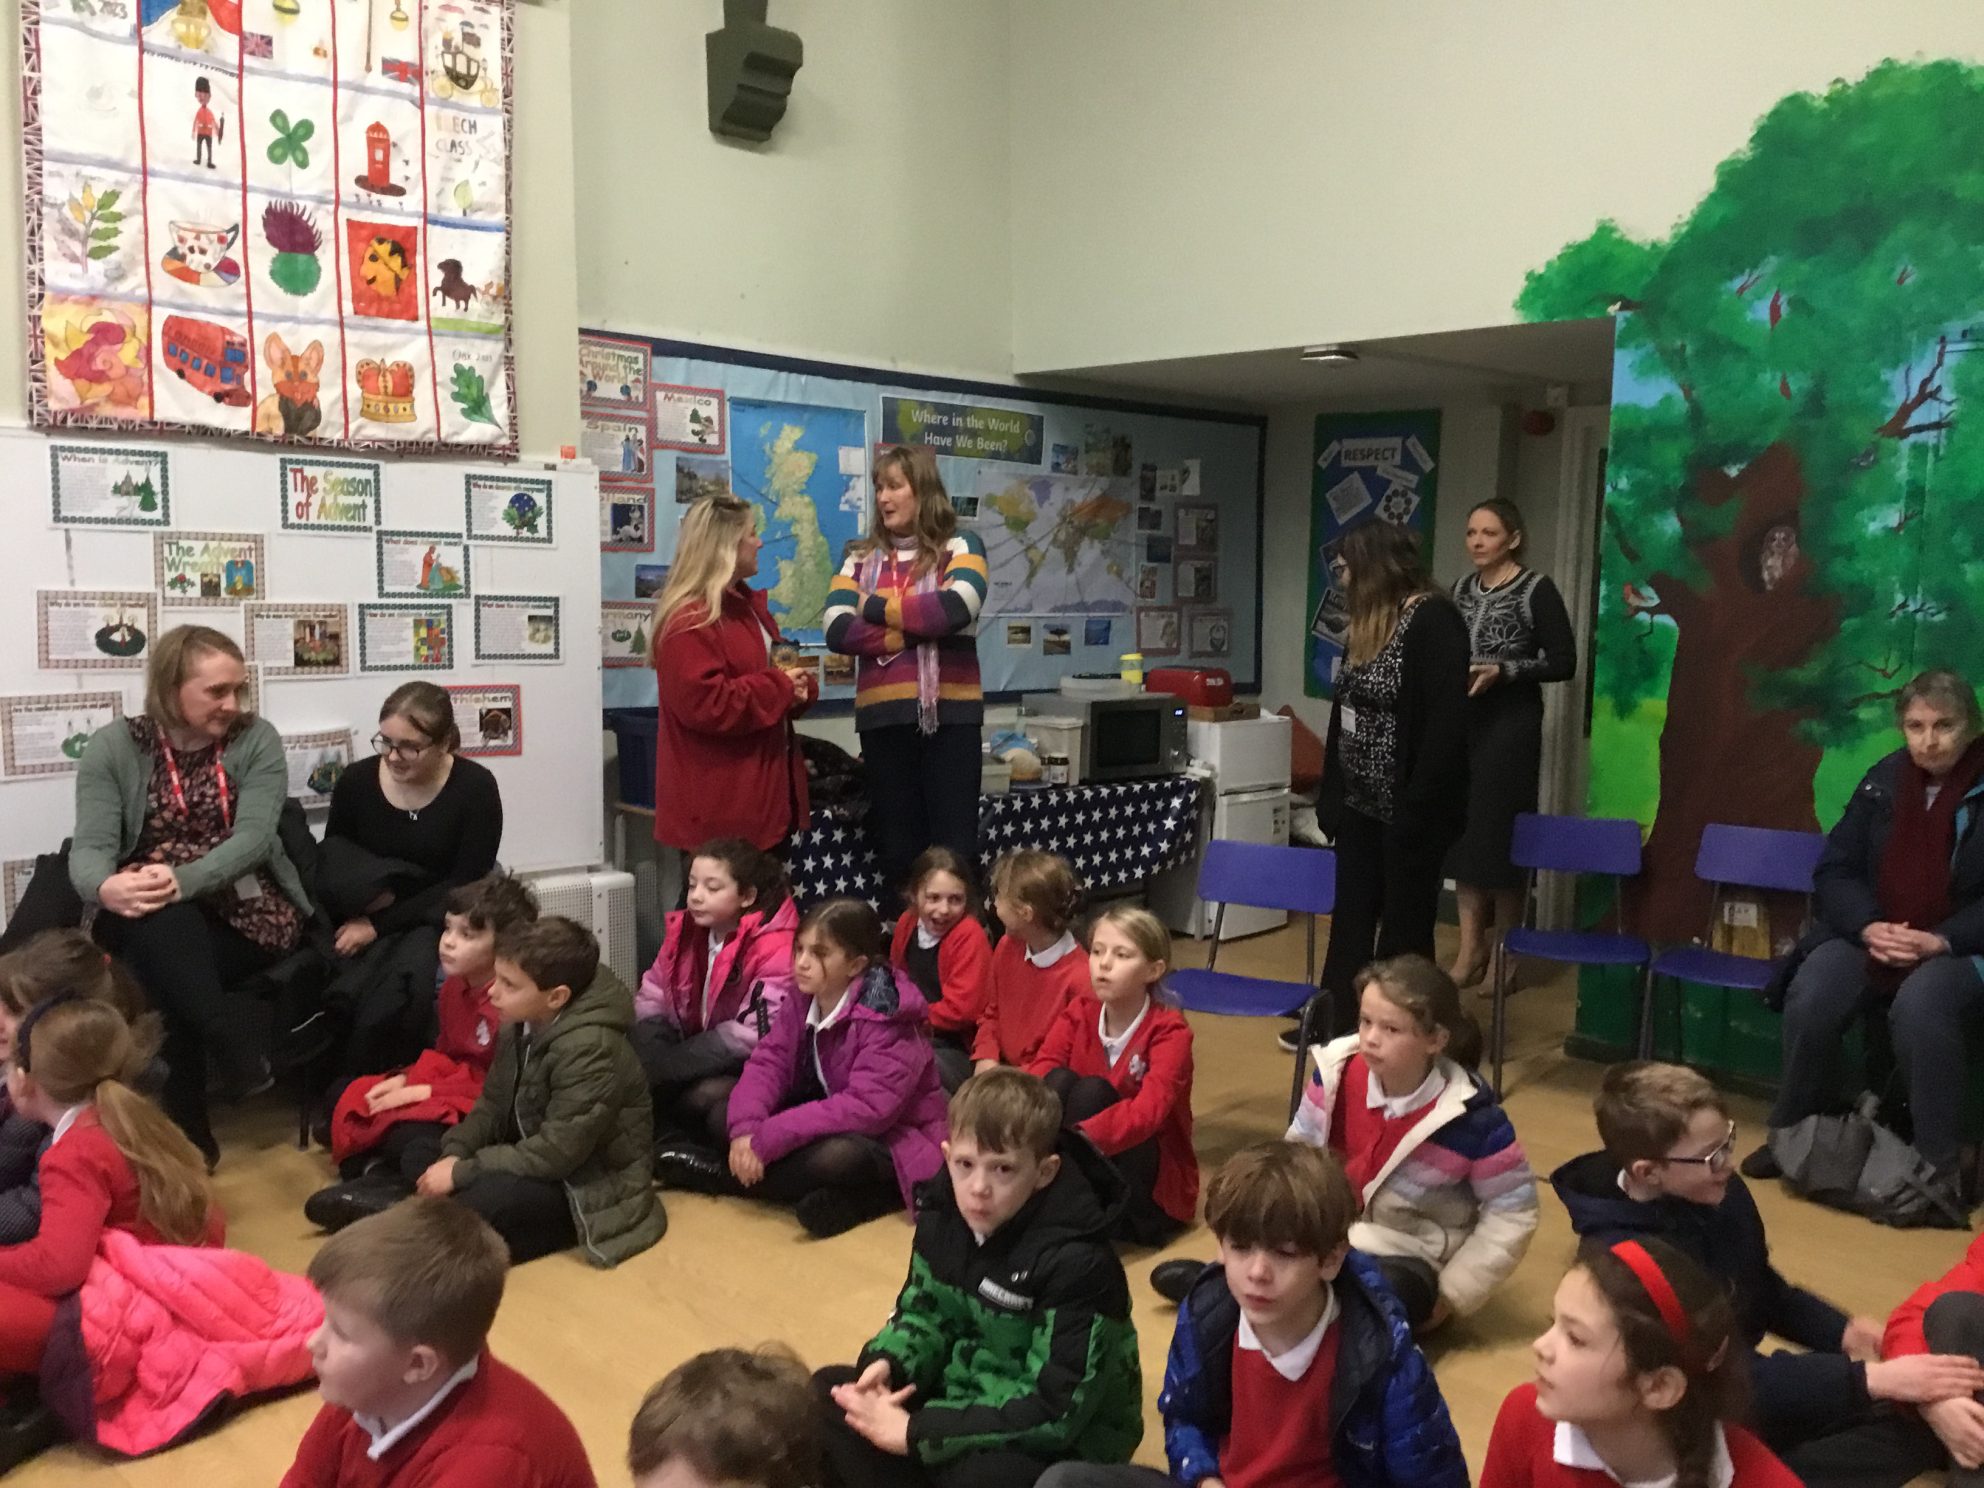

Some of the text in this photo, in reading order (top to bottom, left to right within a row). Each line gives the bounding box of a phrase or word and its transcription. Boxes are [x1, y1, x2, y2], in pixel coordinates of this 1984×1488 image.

[623, 363, 642, 376] the
[664, 393, 712, 406] Mexico
[586, 420, 639, 434] Spain
[911, 409, 1021, 434] Where in the World
[924, 431, 1008, 452] Have We Been?
[1343, 447, 1398, 461] RESPECT
[289, 466, 373, 497] The Season
[296, 491, 367, 522] of Advent
[165, 541, 254, 559] The Advent
